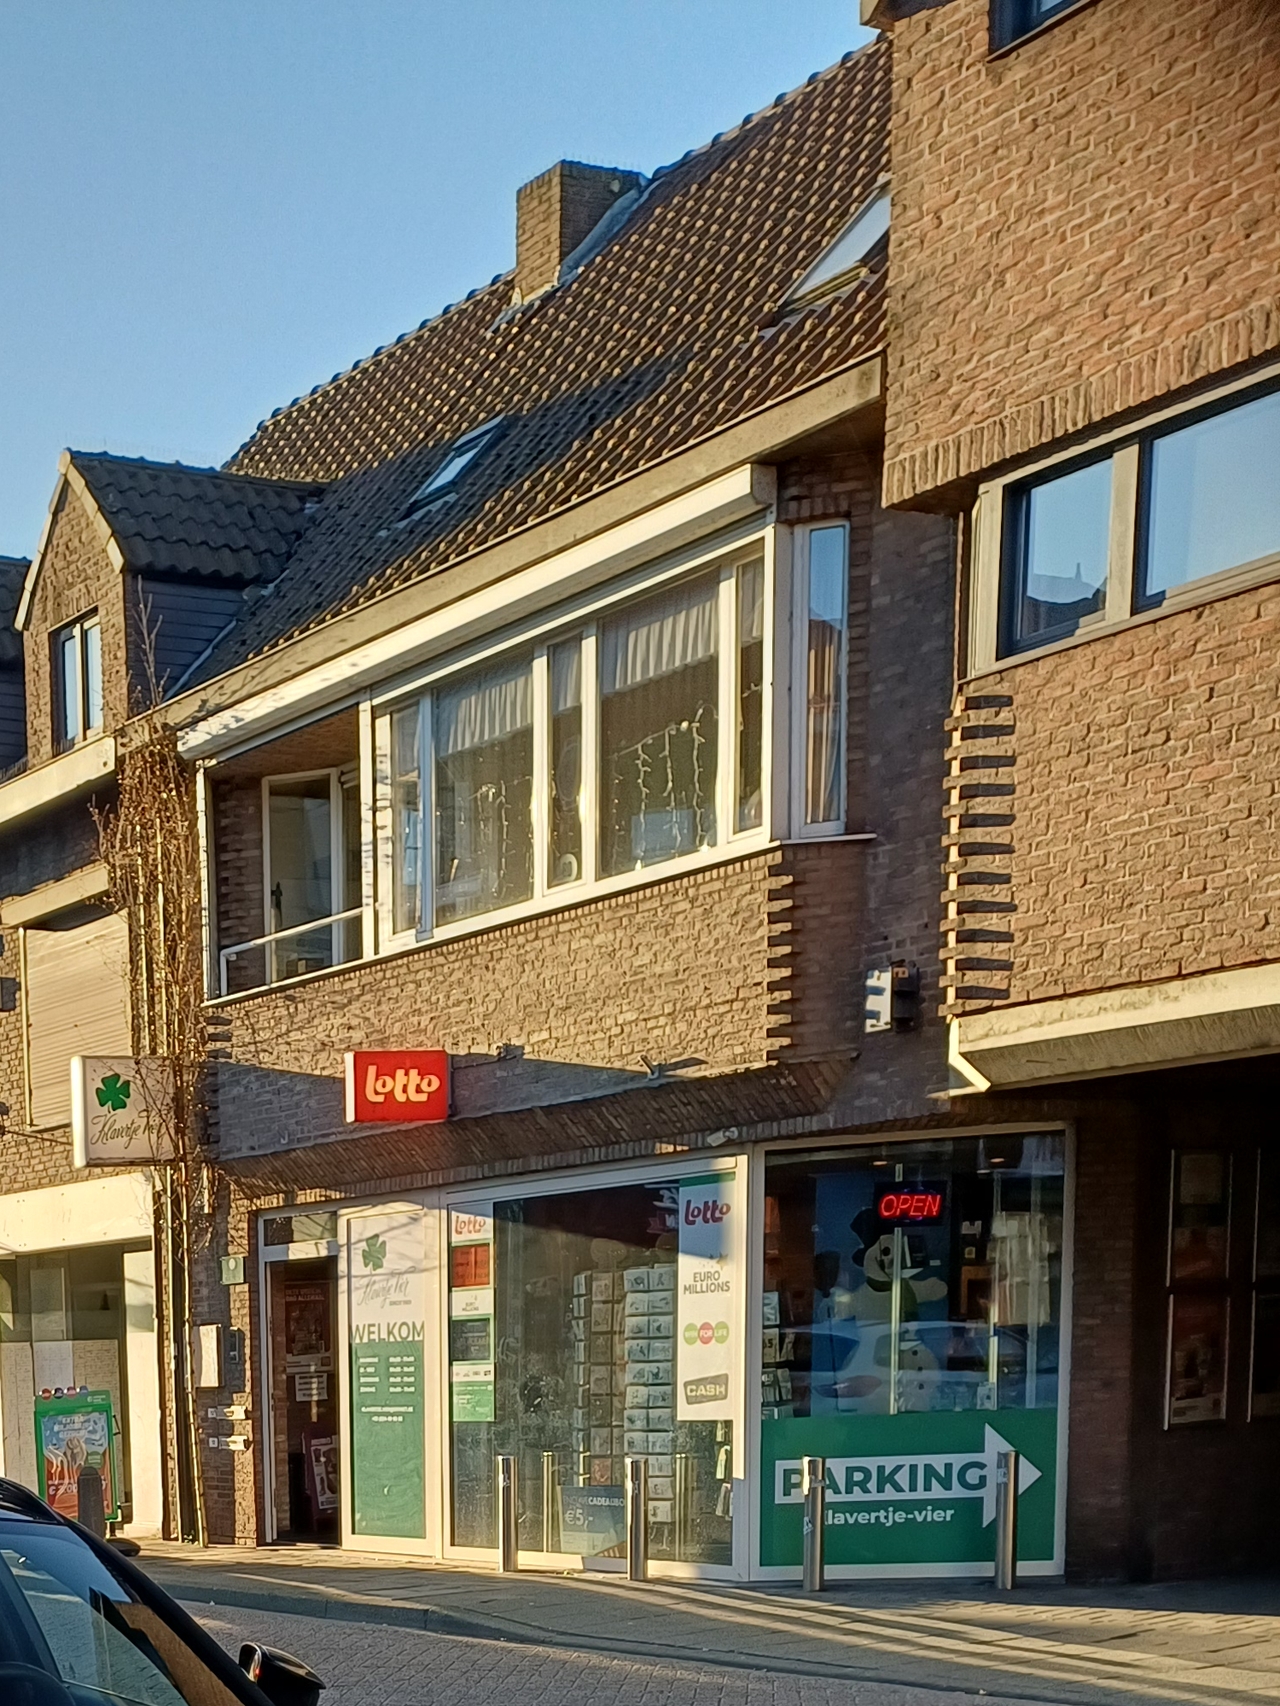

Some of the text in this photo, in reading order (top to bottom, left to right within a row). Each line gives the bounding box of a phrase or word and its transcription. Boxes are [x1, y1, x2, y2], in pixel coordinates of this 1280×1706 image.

[880, 1195, 942, 1217] OPEN
[693, 1270, 721, 1283] EURO
[683, 1281, 731, 1295] MILLIONS
[353, 1321, 425, 1342] WELKOM
[687, 1384, 726, 1396] CASH
[823, 1506, 954, 1527] lavertje-vier
